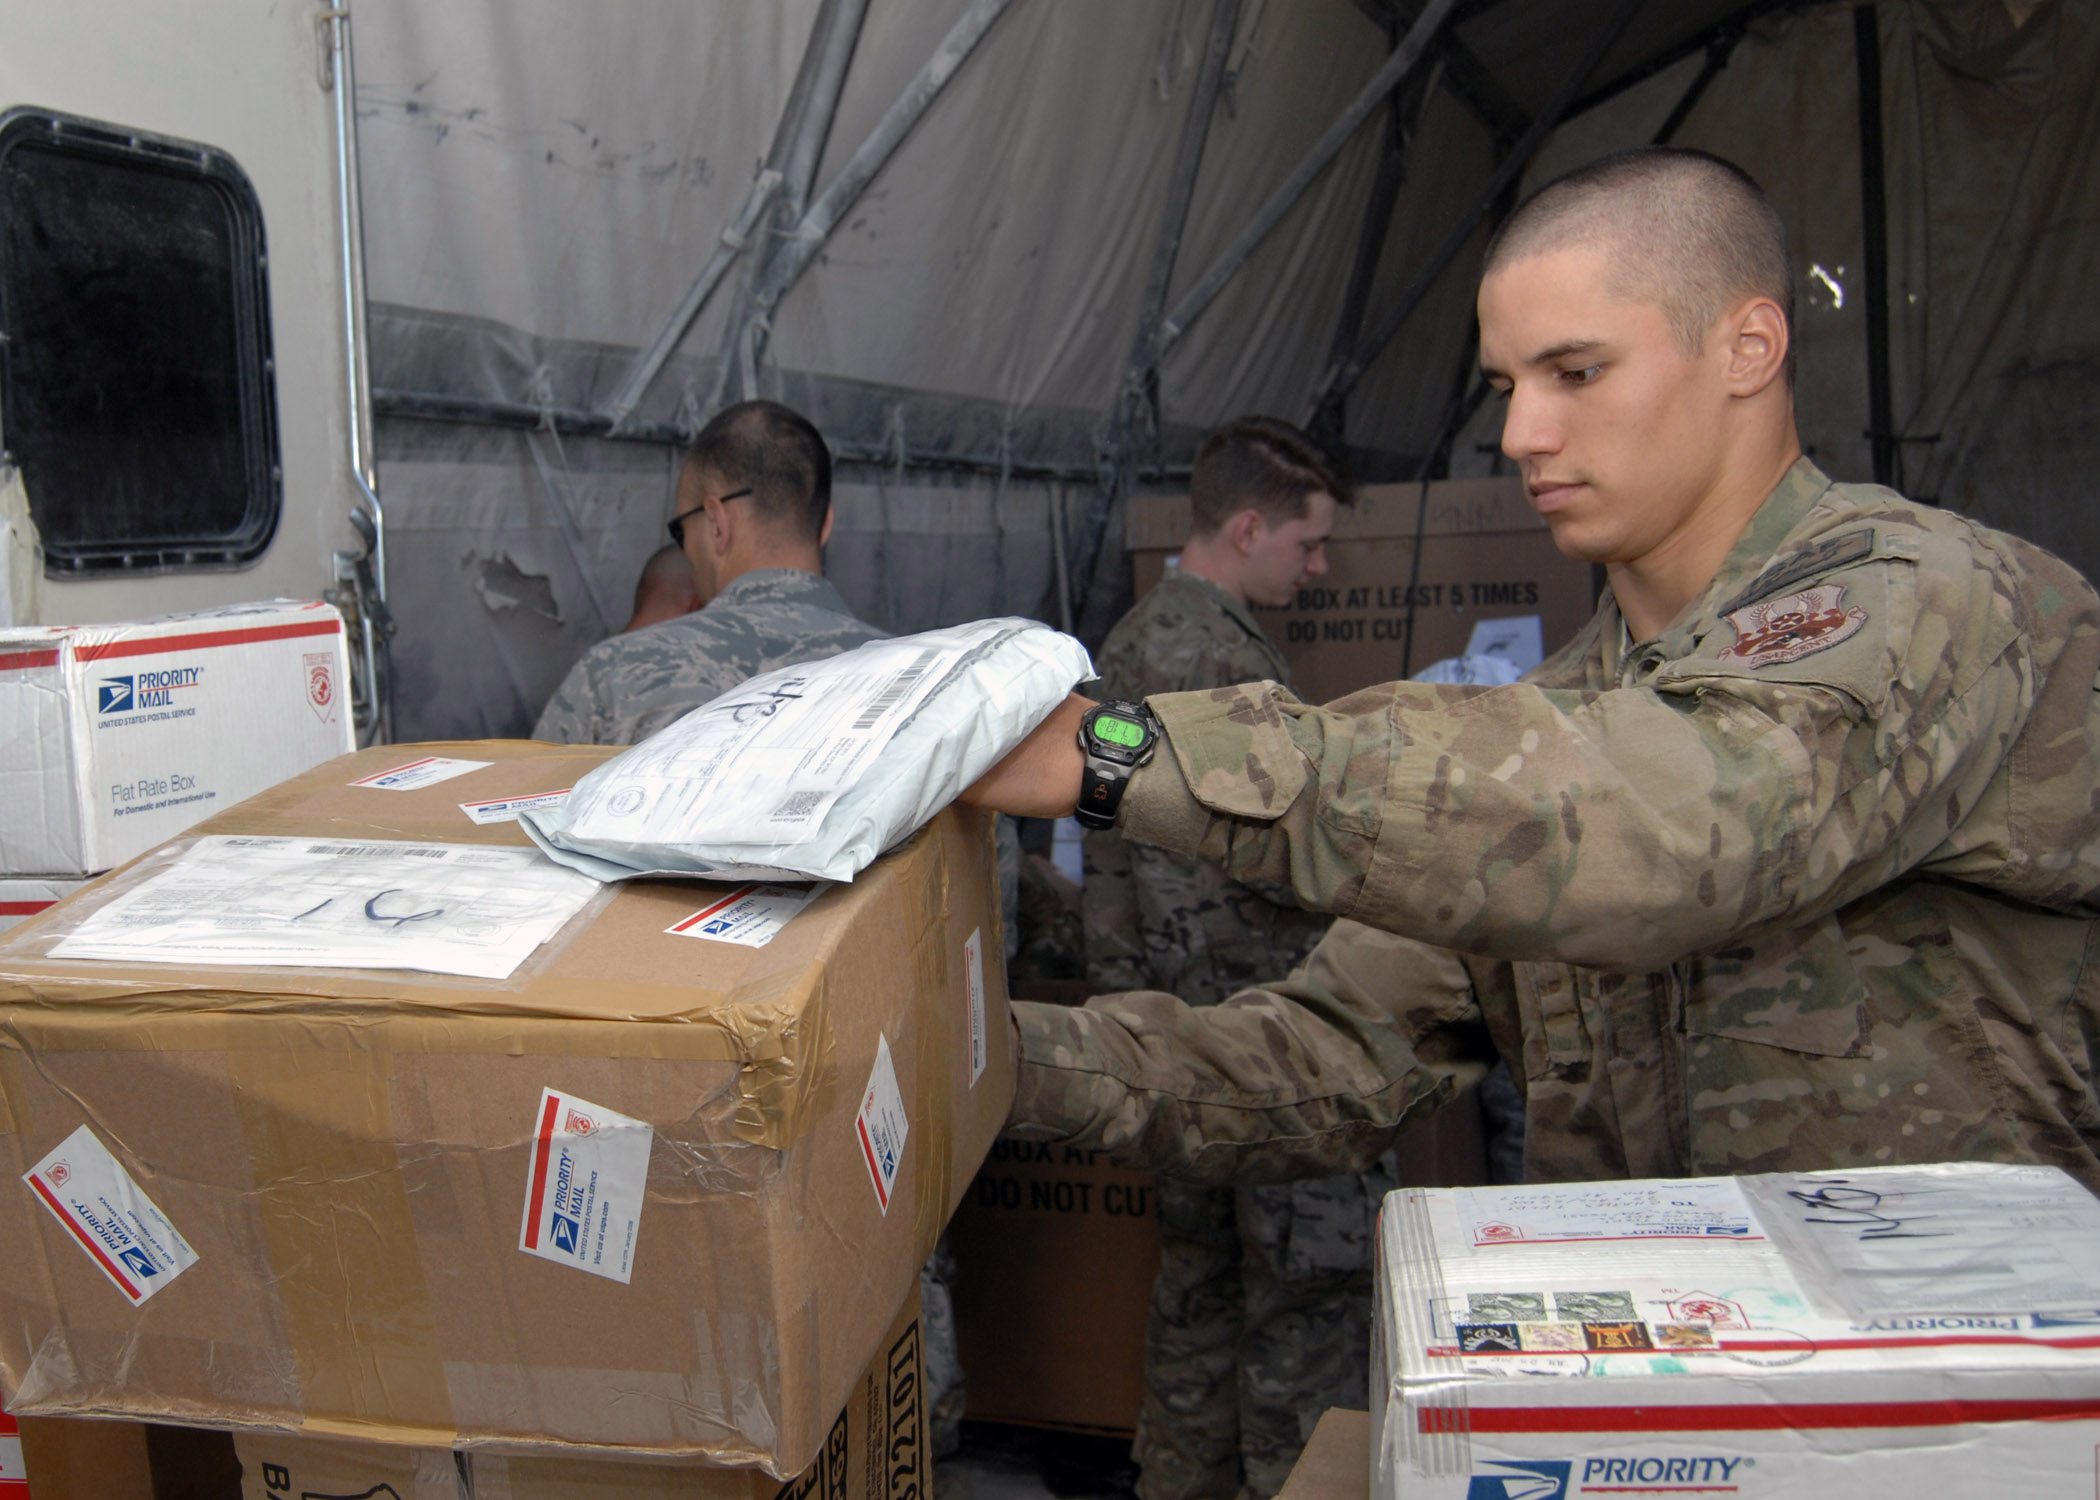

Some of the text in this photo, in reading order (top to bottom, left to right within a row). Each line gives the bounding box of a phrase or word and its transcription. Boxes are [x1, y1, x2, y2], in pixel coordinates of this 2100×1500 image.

[1300, 587, 1342, 611] BOX
[1346, 586, 1371, 609] AT
[1378, 583, 1444, 606] LEAST
[1451, 583, 1464, 604] 5
[1470, 581, 1539, 605] TIMES
[1287, 619, 1317, 643] DO
[1324, 618, 1369, 642] NOT
[138, 667, 200, 690] PRIORITY
[138, 690, 174, 710] MAIL
[98, 708, 196, 729] UNITED STATES POSTAL SERVICE
[111, 774, 196, 803] Flat Rate Box
[113, 790, 216, 817] For Domestic and International Use
[570, 1187, 585, 1218] MAIL
[979, 1175, 1152, 1218] DO NOT CU
[105, 1217, 132, 1246] MAIL
